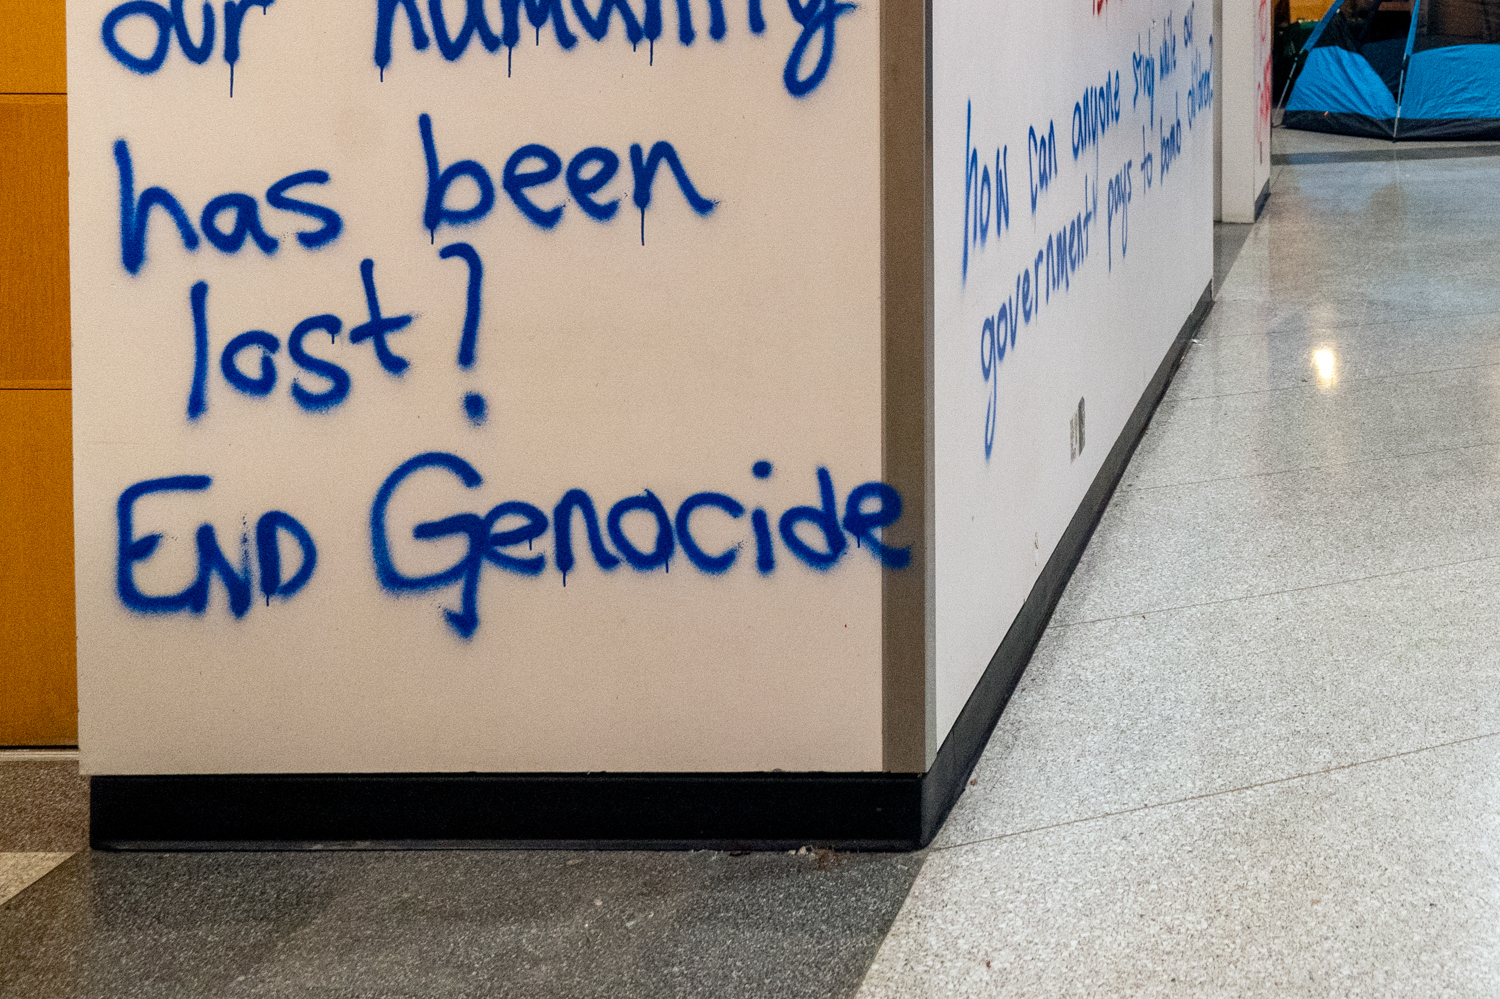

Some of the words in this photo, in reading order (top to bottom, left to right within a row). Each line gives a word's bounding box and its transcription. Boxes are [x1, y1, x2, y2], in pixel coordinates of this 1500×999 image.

[115, 140, 343, 274] has
[419, 114, 715, 230] been
[962, 98, 1010, 287] how
[1072, 70, 1122, 221] anyone
[187, 243, 487, 423] lost?
[980, 174, 1092, 463] government
[1107, 159, 1133, 273] pays
[1141, 125, 1153, 195] to
[370, 452, 911, 639] Genocide
